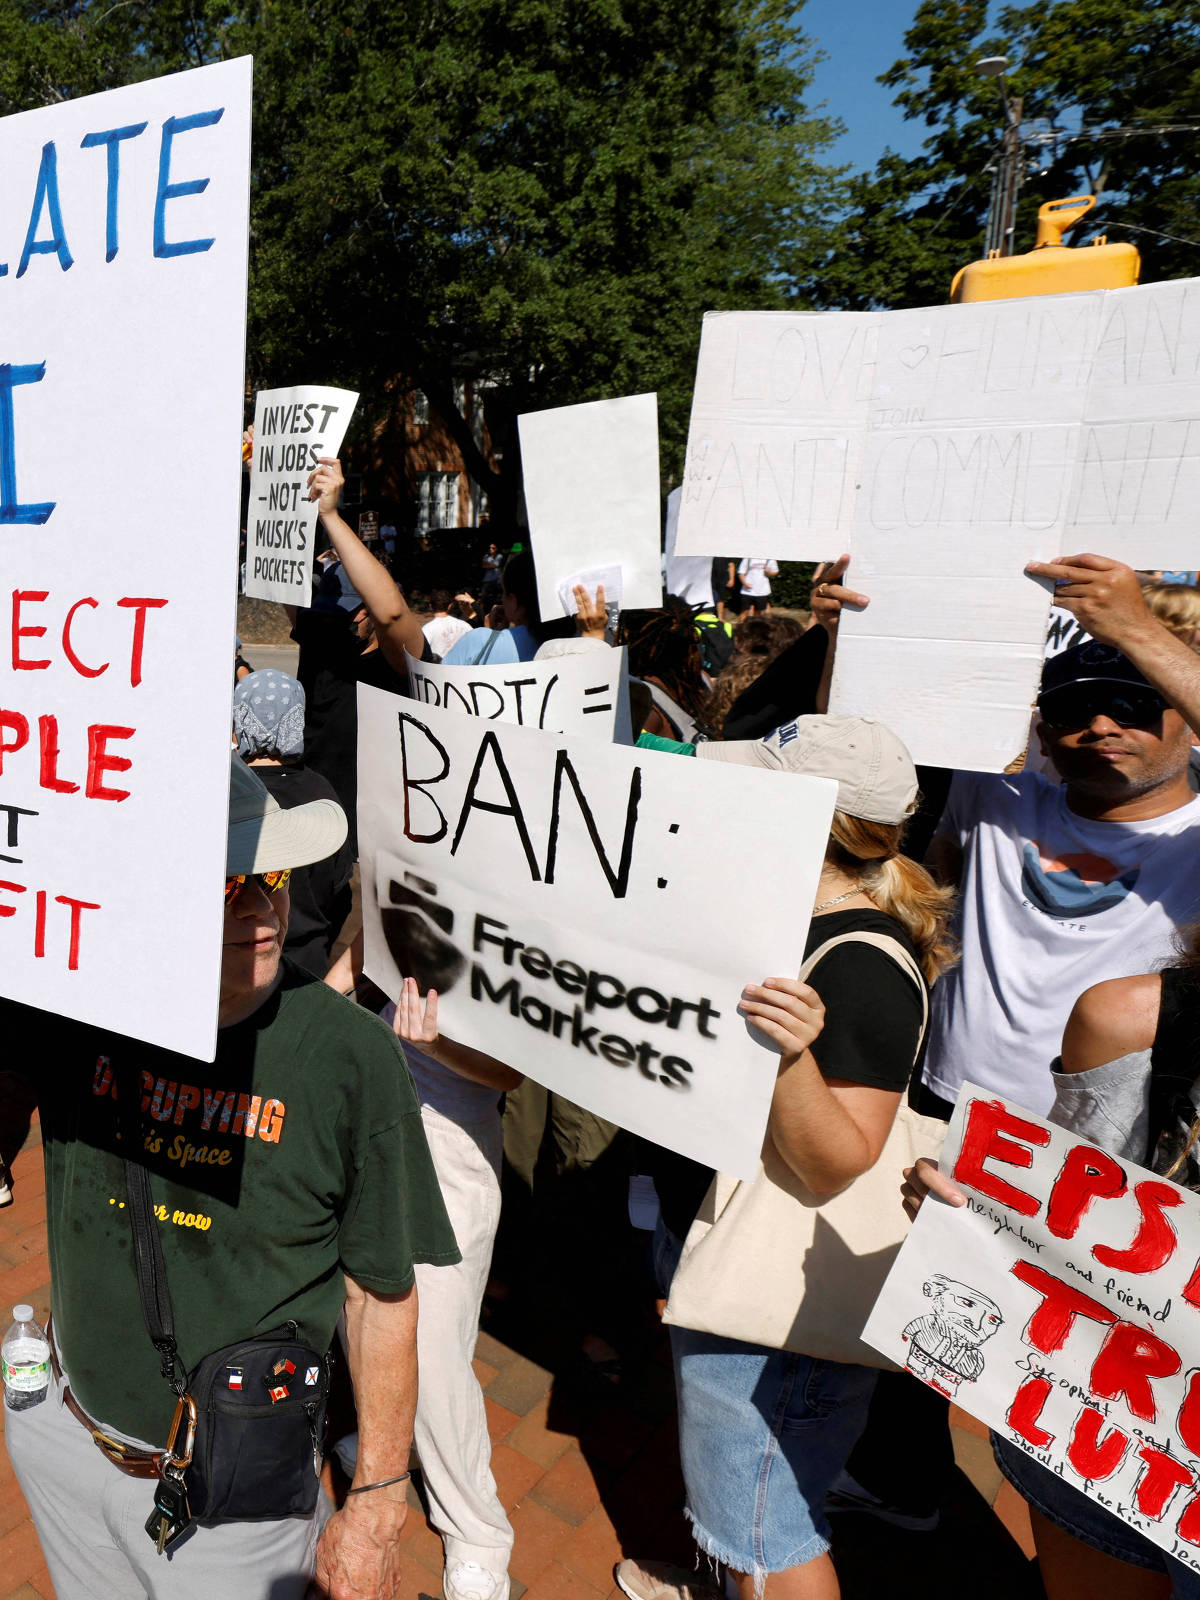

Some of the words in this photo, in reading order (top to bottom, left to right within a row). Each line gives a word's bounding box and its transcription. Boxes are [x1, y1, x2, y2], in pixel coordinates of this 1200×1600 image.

[731, 325, 882, 403] LOVE
[929, 288, 1200, 395] HUMAN
[262, 403, 339, 436] INVEST
[259, 445, 274, 473] IN
[277, 443, 324, 473] JOBS
[256, 519, 307, 551] MUSK'S
[253, 556, 305, 586] POCKETS
[398, 711, 680, 899] BAN:
[472, 911, 722, 1041] Freeport
[469, 966, 697, 1094] Markets
[168, 1134, 232, 1168] Space
[172, 1210, 212, 1231] now
[952, 1098, 1200, 1309] EPS
[966, 1196, 1047, 1254] neighbor
[1065, 1260, 1095, 1285] and
